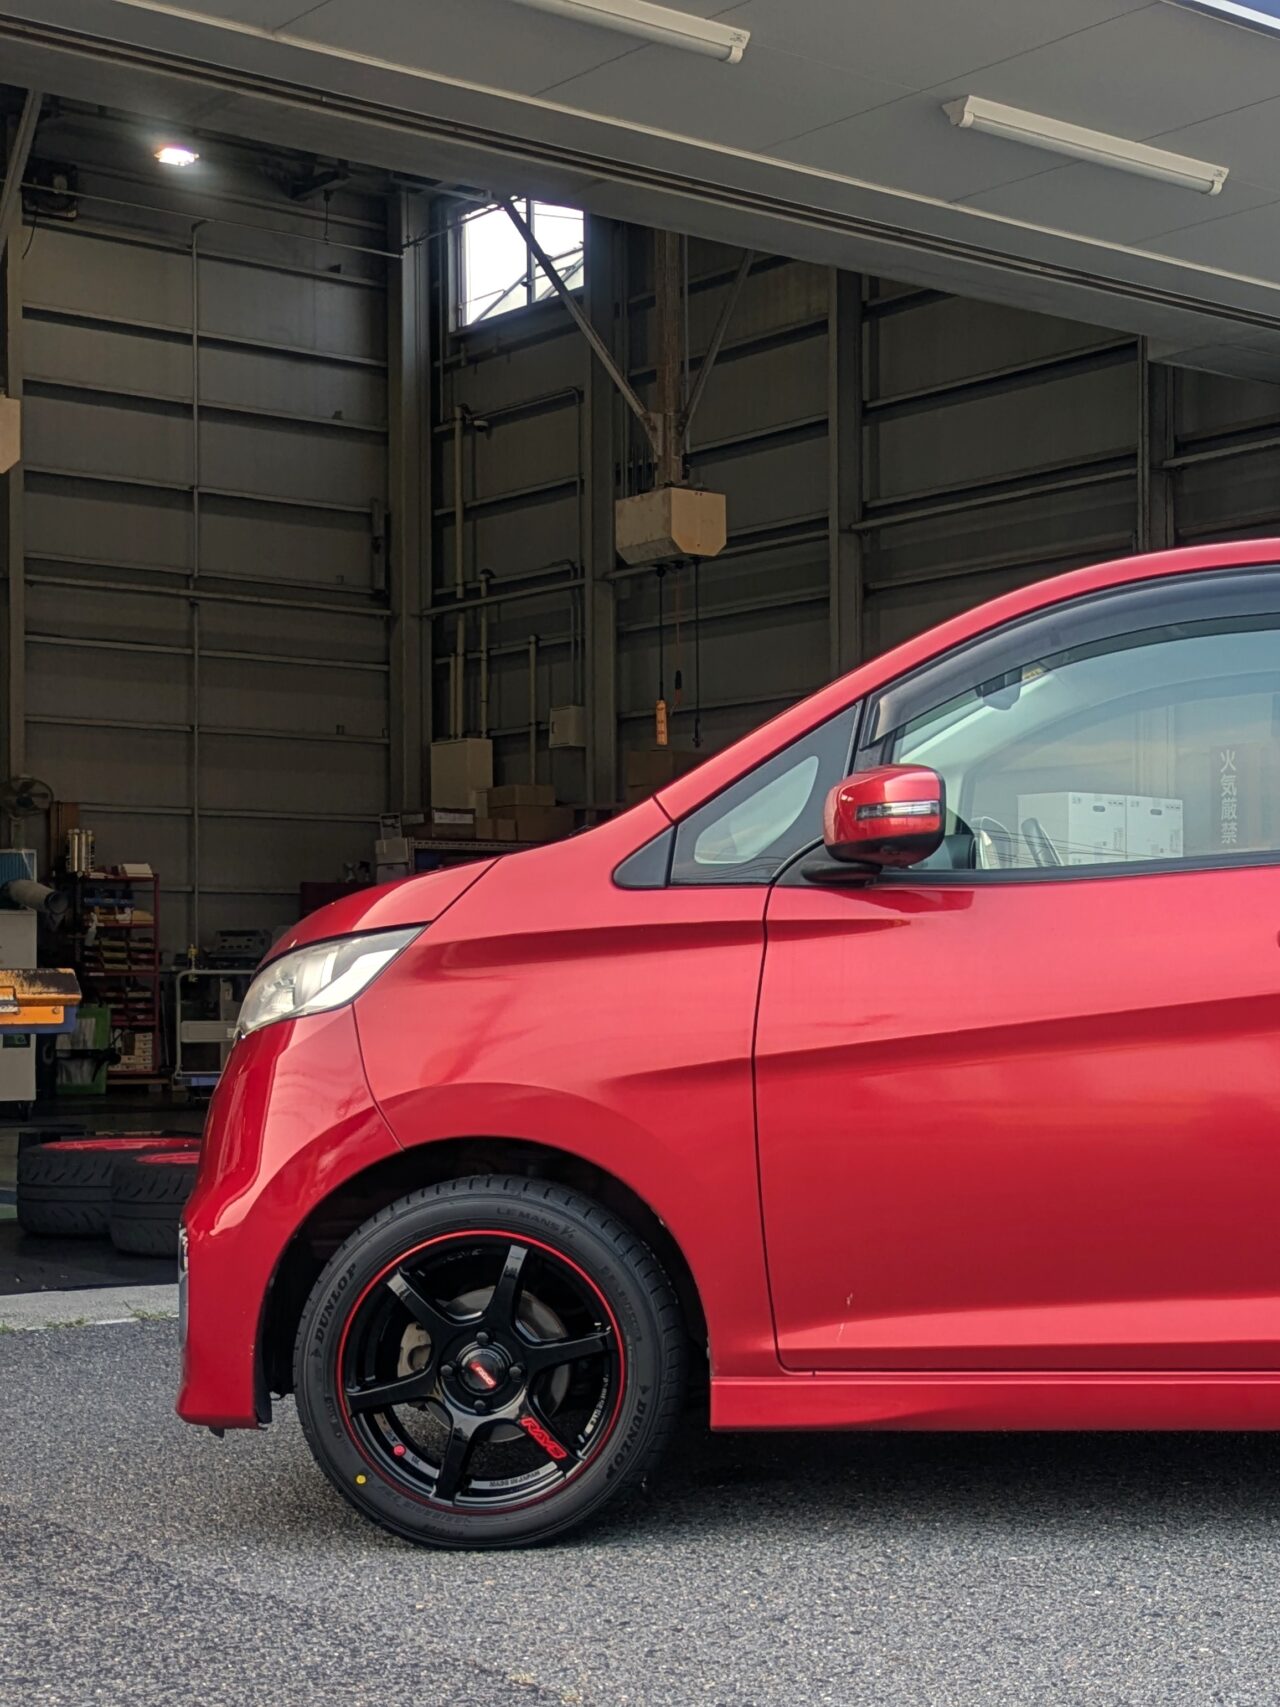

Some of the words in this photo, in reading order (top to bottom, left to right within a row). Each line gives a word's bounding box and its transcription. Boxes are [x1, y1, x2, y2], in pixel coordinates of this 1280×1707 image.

[1220, 748, 1237, 845] 火気厳禁
[518, 1210, 561, 1231] MANS
[314, 1263, 357, 1343] DUNLOP
[519, 1415, 567, 1460] RAYS
[605, 1400, 647, 1482] DUNLOP
